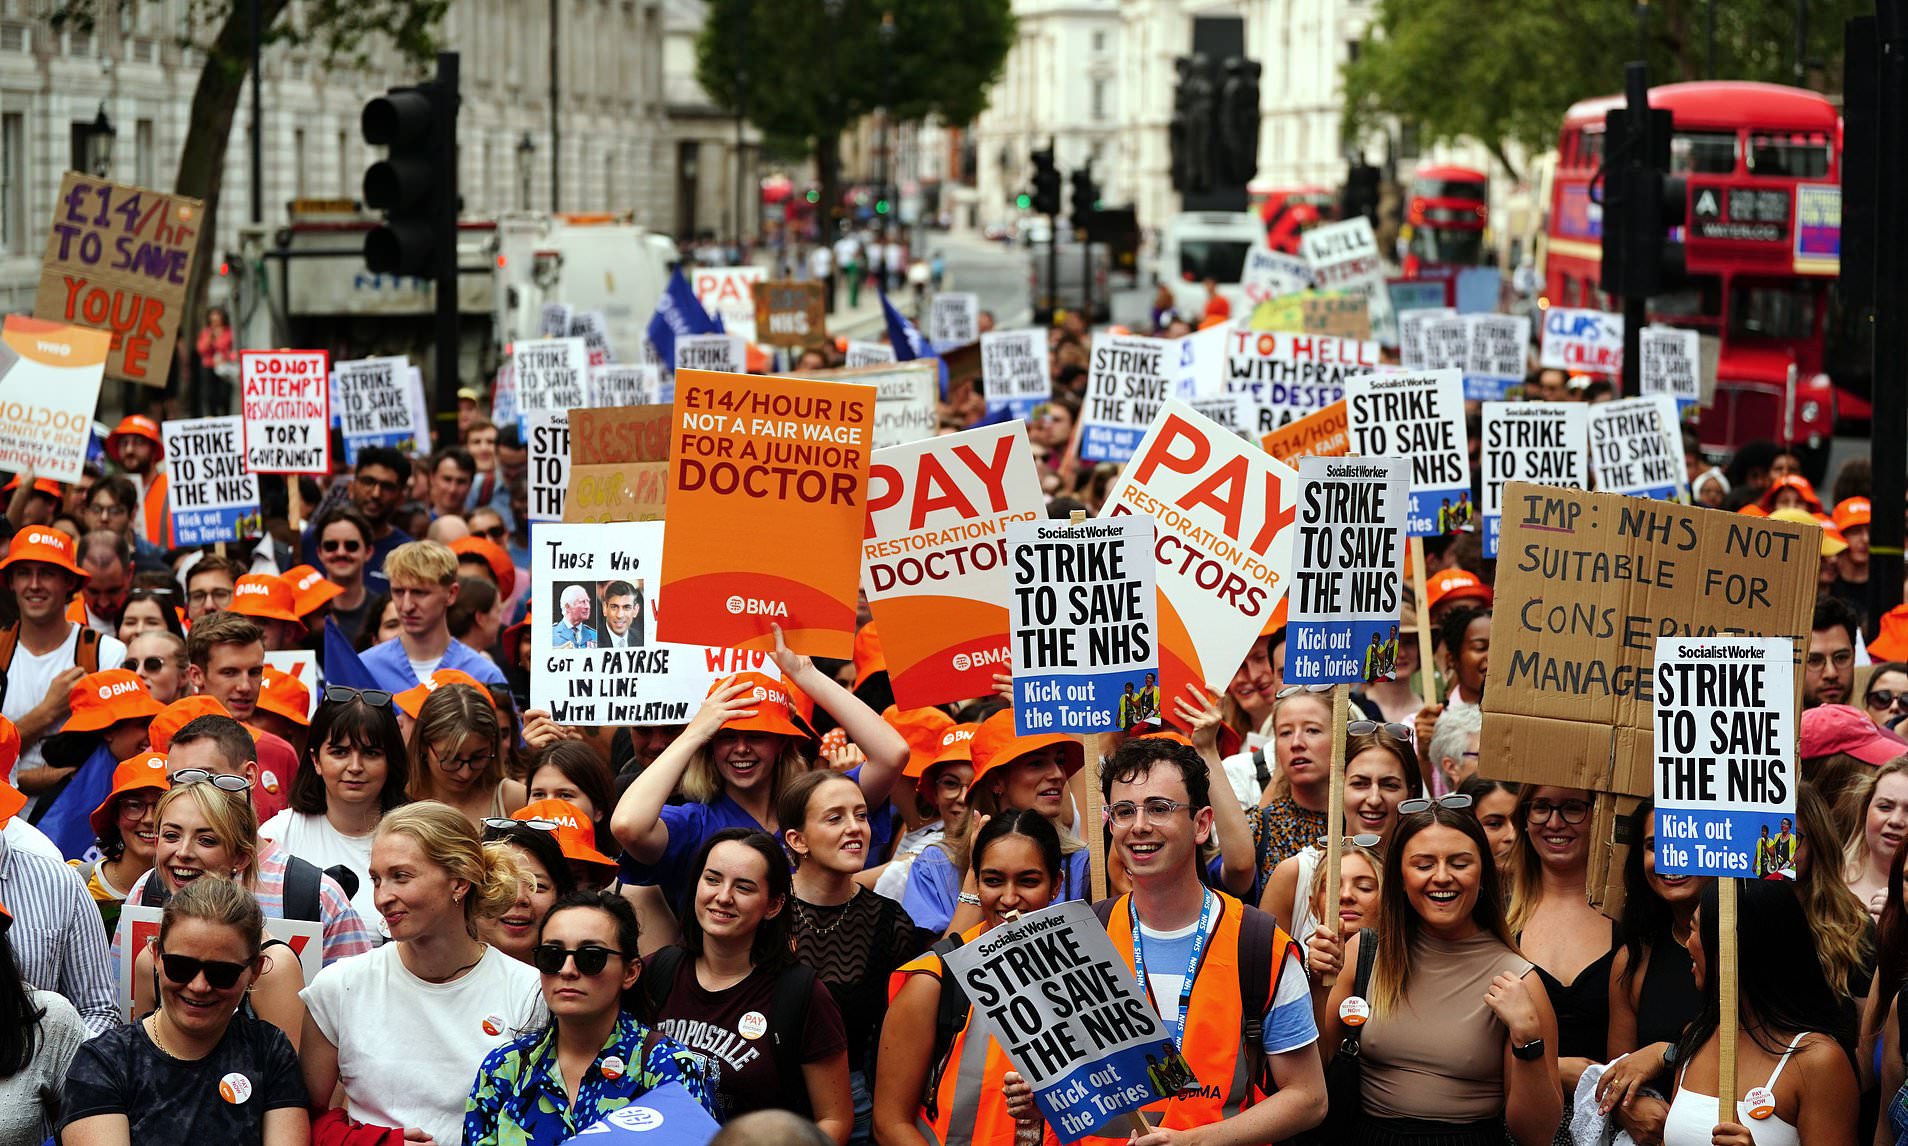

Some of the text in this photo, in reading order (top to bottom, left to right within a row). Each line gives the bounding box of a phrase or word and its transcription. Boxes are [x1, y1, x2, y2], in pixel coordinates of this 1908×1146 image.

[64, 183, 194, 246] £14/hr
[1696, 190, 1719, 217] A
[54, 222, 189, 285] TO SAVE
[64, 275, 165, 339] YOUR
[518, 350, 569, 370] STRIKE
[679, 346, 731, 365] STRIKE
[1095, 347, 1162, 376] STRIKE
[1234, 331, 1276, 356] TO
[1292, 337, 1374, 367] HELL
[255, 359, 320, 375] DO NOT
[340, 370, 394, 390] STRIKE
[519, 370, 578, 389] TO SAVE
[1229, 358, 1297, 381] WITH
[246, 377, 324, 397] ATTEMPT
[598, 375, 643, 391] STRIKE
[1094, 372, 1169, 401] TO SAVE
[345, 389, 405, 411] TO SAVE
[520, 389, 583, 409] THE NHS
[685, 386, 864, 423] £14/HOUR IS
[1091, 398, 1125, 422] THE
[1353, 390, 1440, 424] STRIKE
[345, 410, 410, 431] THE NHS
[682, 412, 727, 433] NOT
[730, 418, 746, 434] A
[751, 419, 797, 439] FAIR
[802, 423, 862, 445] WAGE
[1593, 410, 1661, 440] STRIKE
[169, 431, 236, 458] STRIKE
[265, 425, 310, 443] TORY
[1354, 421, 1456, 456] TO SAVE
[1488, 420, 1567, 448] STRIKE
[249, 448, 323, 468] GOVERNMENT
[681, 434, 860, 470] FOR A JUNIOR
[1487, 451, 1577, 478] TO SAVE
[1596, 441, 1621, 465] TO
[170, 460, 195, 482] TO
[533, 456, 562, 485] TO
[1413, 453, 1462, 485] NHS
[1599, 465, 1637, 489] THE
[172, 479, 254, 507] THE NHS
[678, 458, 858, 507] DOCTOR
[863, 434, 1016, 541] PAY
[1133, 413, 1297, 557] PAY
[1302, 480, 1388, 524] STRIKE
[177, 512, 221, 526] Kick out
[41, 534, 64, 551] BMA
[864, 520, 996, 560] RESTORATION
[1121, 484, 1281, 588] RESTORATION FOR
[1617, 507, 1698, 551] NHS
[1725, 524, 1800, 562] NOT
[610, 551, 640, 570] WHO
[1300, 527, 1397, 569] TO SAVE
[1014, 540, 1126, 585] STRIKE
[243, 583, 269, 596] BMA
[1518, 544, 1772, 609] SUITABLE FOR
[1015, 581, 1143, 627] TO SAVE
[1297, 571, 1398, 613] THE NHS
[746, 598, 788, 617] BMA
[1016, 622, 1150, 669] THE NHS
[1297, 627, 1351, 650] Kick out
[546, 657, 574, 673] GOT
[583, 657, 593, 672] A
[705, 648, 765, 673] WHO
[970, 646, 1012, 667] BMA
[1295, 655, 1358, 678] the Tories
[112, 680, 140, 697] BMA
[568, 678, 638, 697] IN LINE
[1507, 650, 1654, 701] MANAGE
[1658, 662, 1765, 707] STRIKE
[1024, 681, 1095, 703] Kick out
[550, 700, 688, 721] WITH INFLATION
[1024, 706, 1111, 729] the Tories
[1658, 710, 1781, 756] TO SAVE
[1659, 756, 1786, 804] THE NHS
[1662, 815, 1733, 840] Kick out
[1663, 844, 1748, 869] the Tories
[1132, 925, 1140, 942] NHS
[1200, 913, 1208, 931] NHS
[1194, 935, 1203, 952] NHS
[966, 926, 1092, 1007] STRIKE
[1136, 969, 1144, 987] NHS
[1188, 956, 1197, 974] NHS
[986, 961, 1130, 1045] TO SAVE
[745, 1014, 764, 1026] PAY
[1177, 1013, 1185, 1031] NHS
[1011, 998, 1156, 1082] THE NHS
[1045, 1063, 1122, 1112] Kick out
[1060, 1083, 1149, 1136] the Tories
